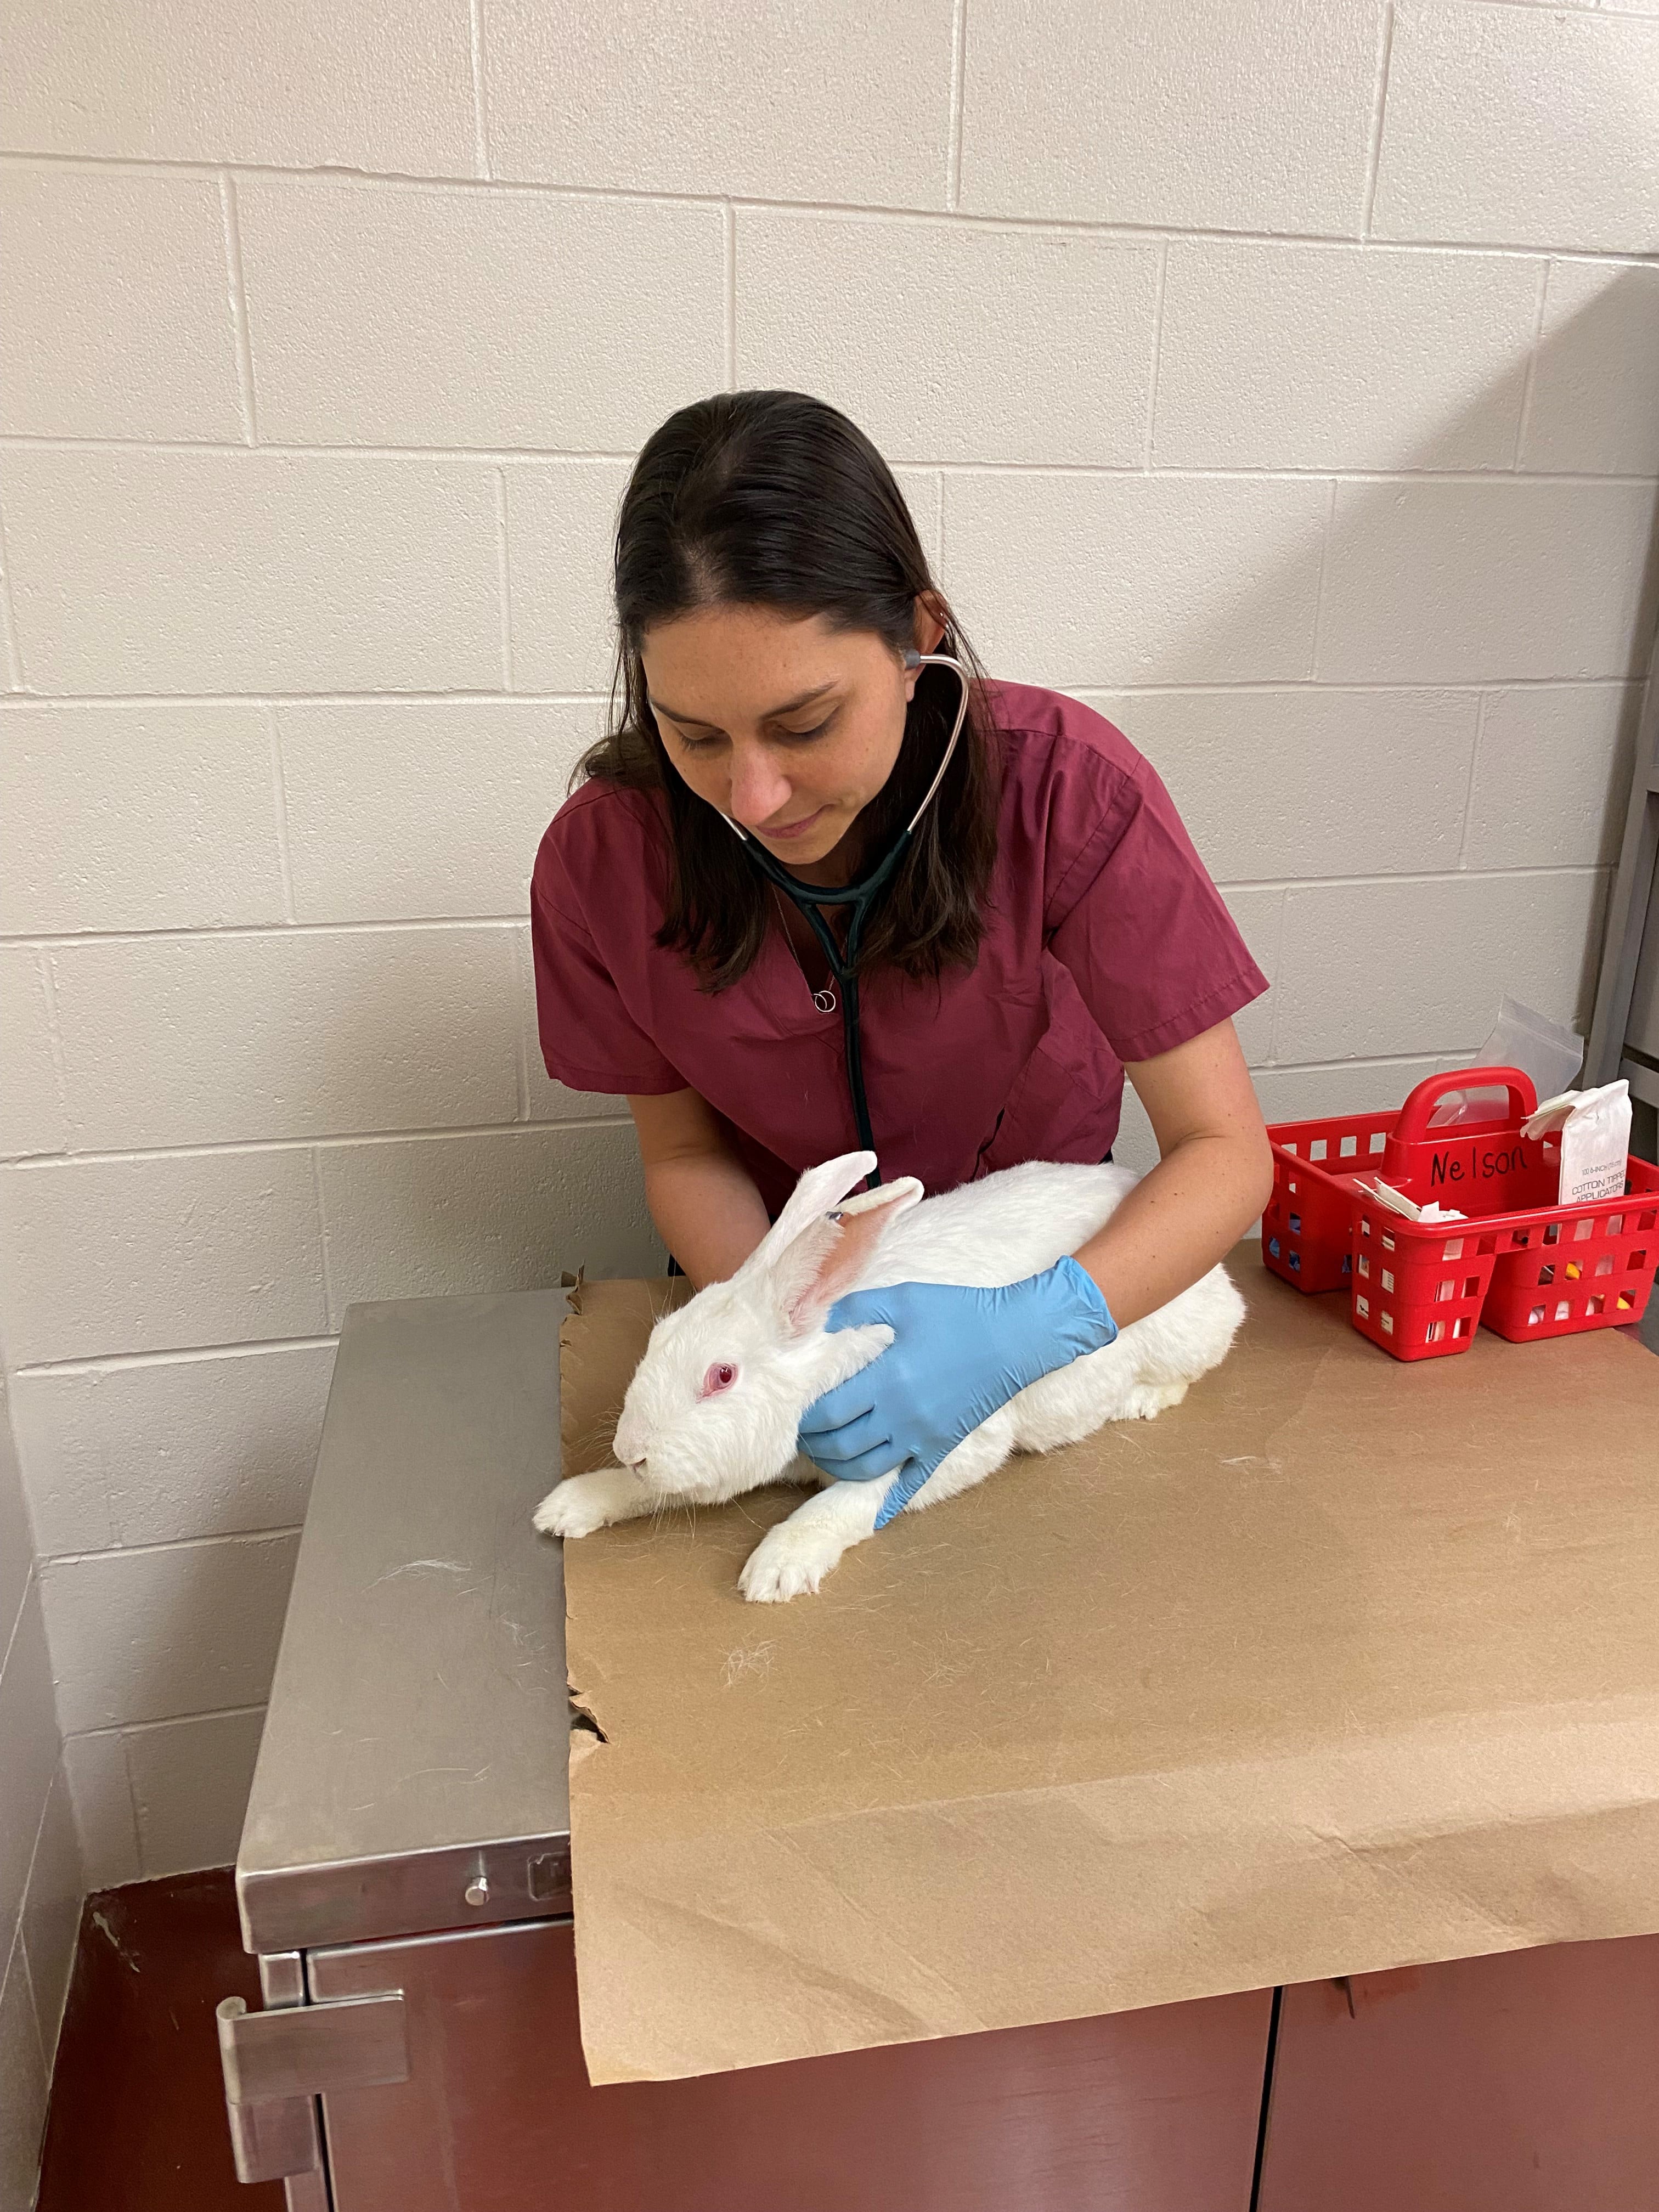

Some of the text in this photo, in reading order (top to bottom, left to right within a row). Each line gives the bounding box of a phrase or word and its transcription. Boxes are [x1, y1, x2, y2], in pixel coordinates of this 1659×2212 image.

[1431, 1146, 1527, 1187] Nelson
[1572, 1179, 1605, 1195] COTTON
[1576, 1180, 1624, 1203] APPLICATORS
